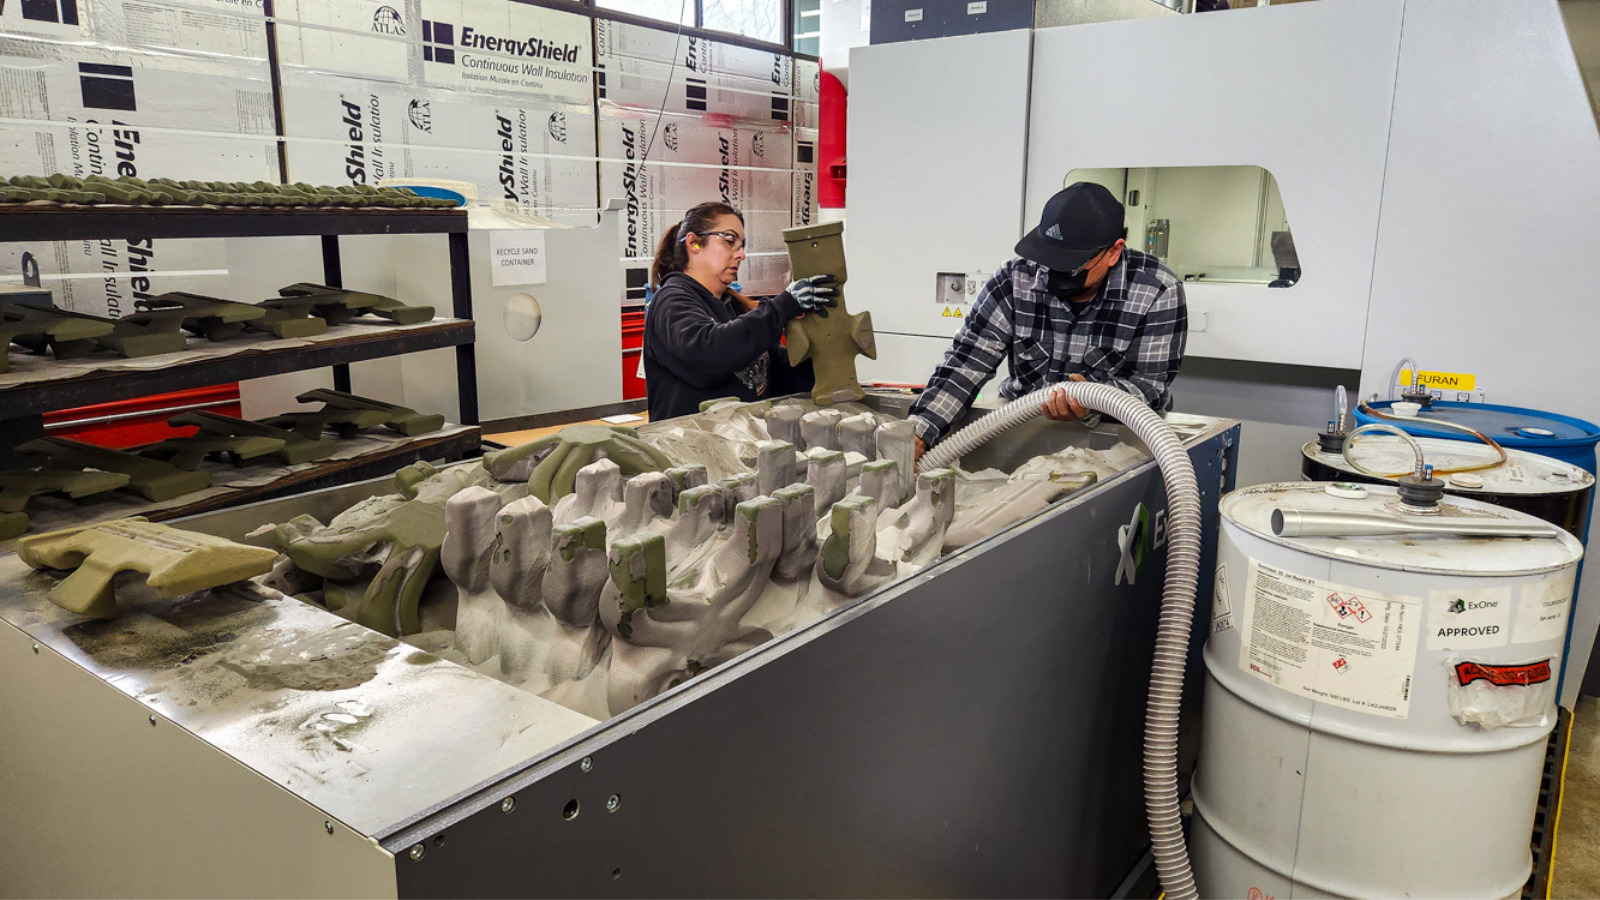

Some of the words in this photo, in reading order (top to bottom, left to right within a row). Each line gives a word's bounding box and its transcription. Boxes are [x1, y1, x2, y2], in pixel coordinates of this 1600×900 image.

[371, 22, 406, 37] ATLAS
[460, 26, 579, 64] EnergyShield
[461, 54, 519, 75] Continuous
[521, 62, 544, 78] Wall
[545, 69, 588, 84] Insulation
[496, 247, 521, 256] RECYCLE
[522, 247, 538, 256] SAND
[501, 258, 535, 267] CONTAINER
[1417, 374, 1458, 386] FURAN
[1468, 600, 1498, 610] ExOne
[1437, 625, 1500, 637] APPROVED
